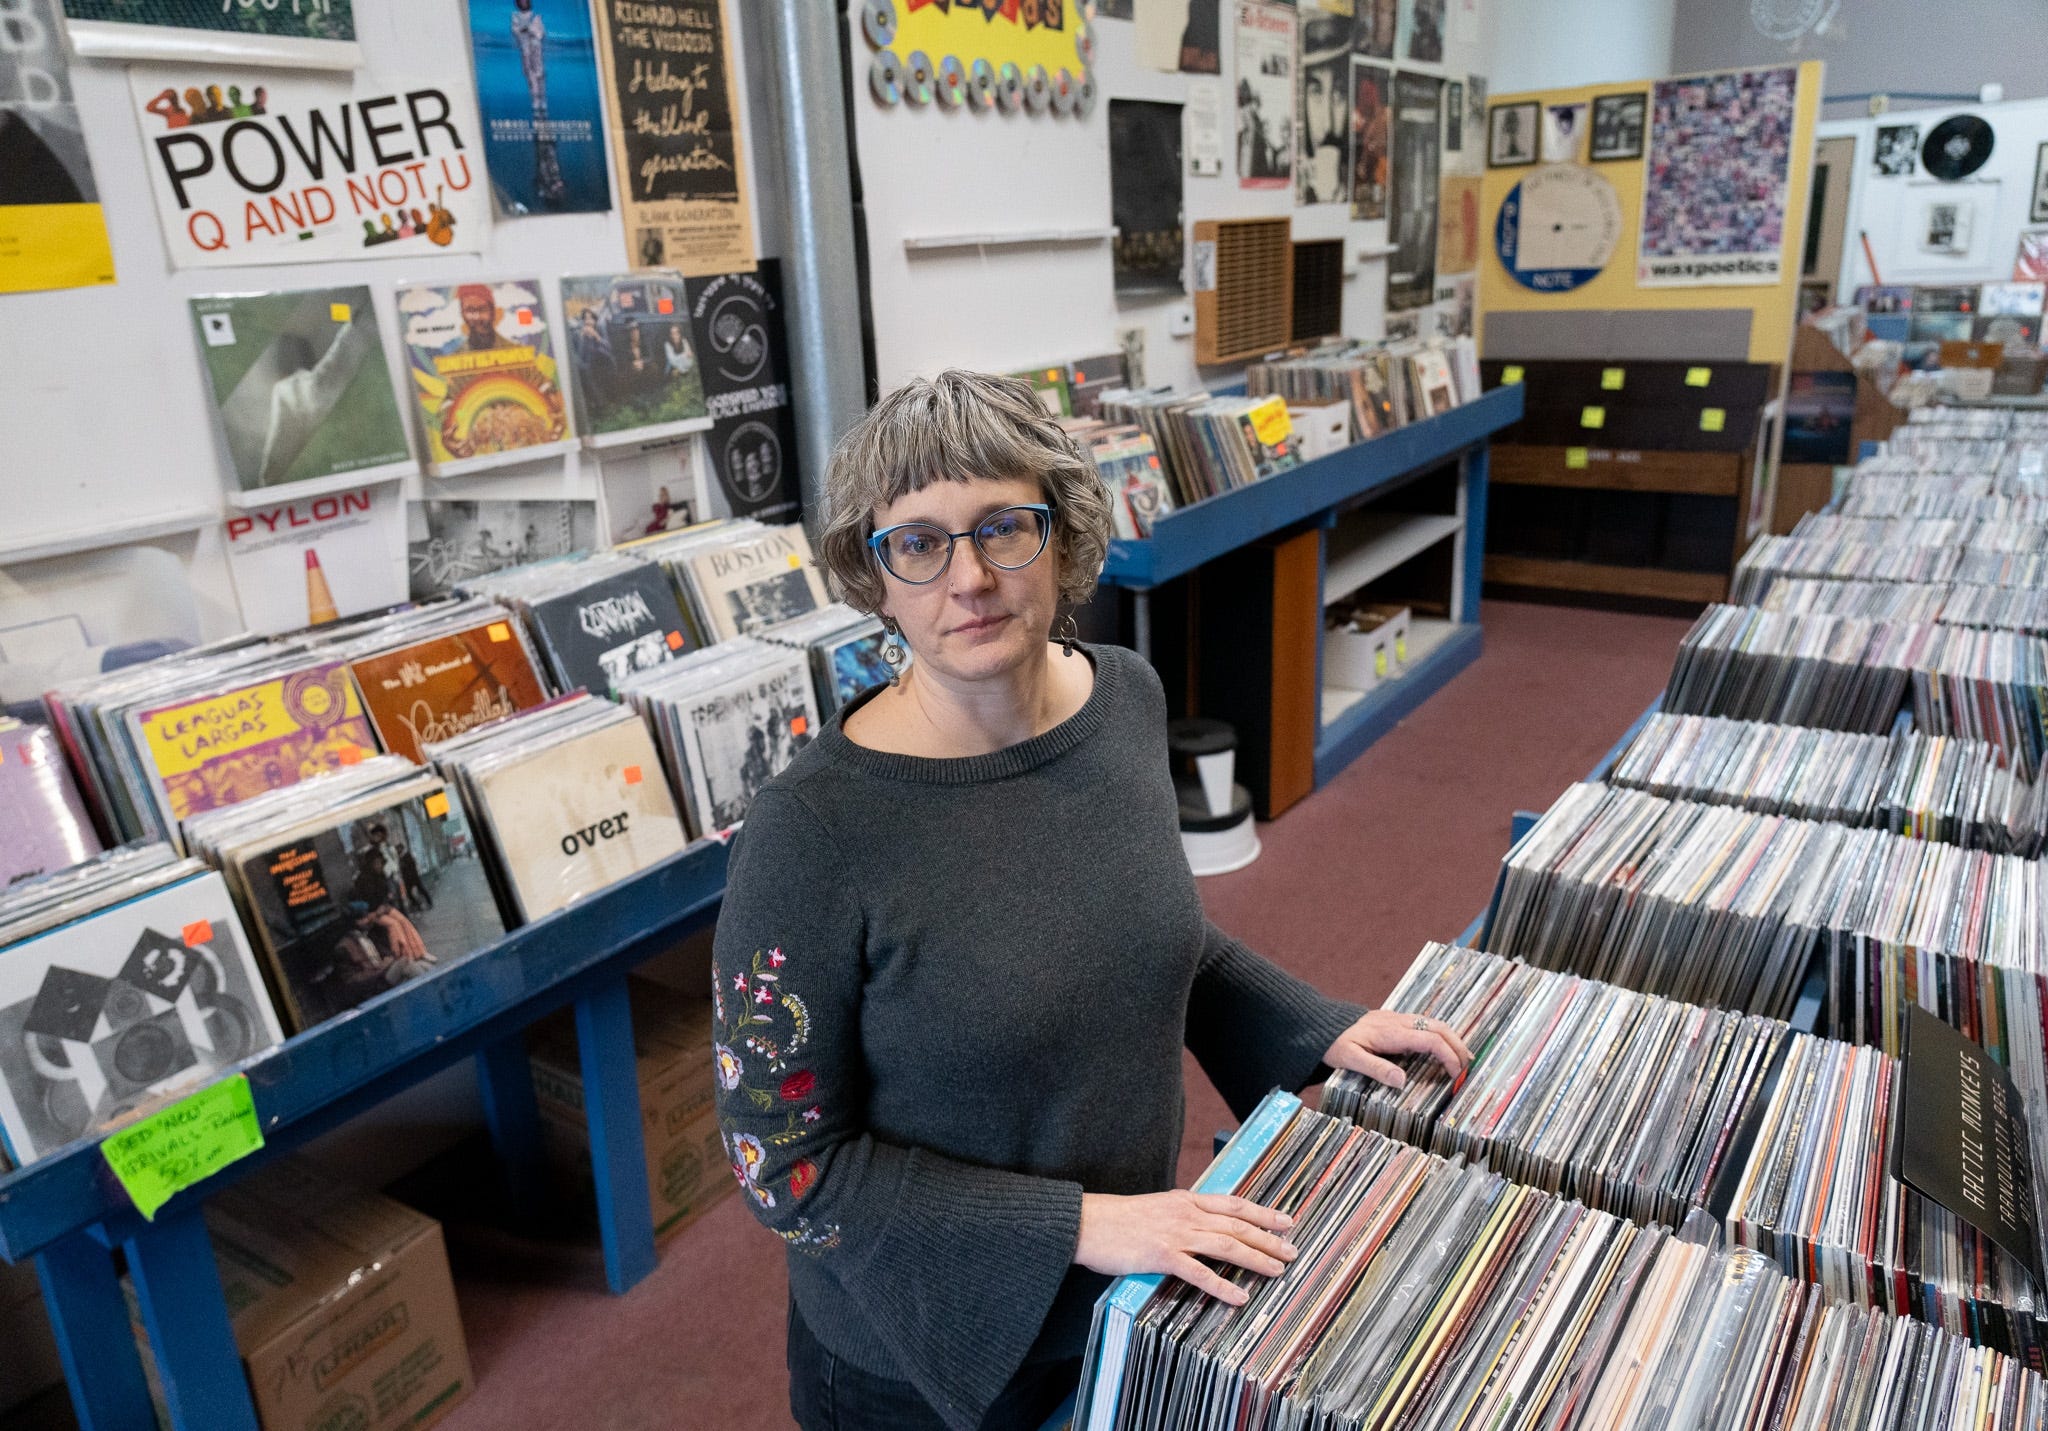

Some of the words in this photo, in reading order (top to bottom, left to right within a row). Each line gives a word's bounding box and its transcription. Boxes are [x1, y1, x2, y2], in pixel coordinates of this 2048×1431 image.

[155, 89, 464, 210] POWER
[187, 210, 230, 251] Q
[244, 186, 337, 242] AND
[346, 163, 427, 214] NOT
[441, 154, 471, 191] U
[1650, 260, 1779, 279] waxpoetics
[226, 491, 370, 541] PYLON
[710, 533, 796, 580] BOSTON
[160, 690, 266, 742] LENGUAS
[181, 716, 271, 759] LARGAS
[560, 810, 629, 857] over
[1959, 1050, 1983, 1132] MONKEYS
[1961, 1130, 1986, 1210] ARCTIC
[1995, 1121, 2017, 1231] TRANQUILITY
